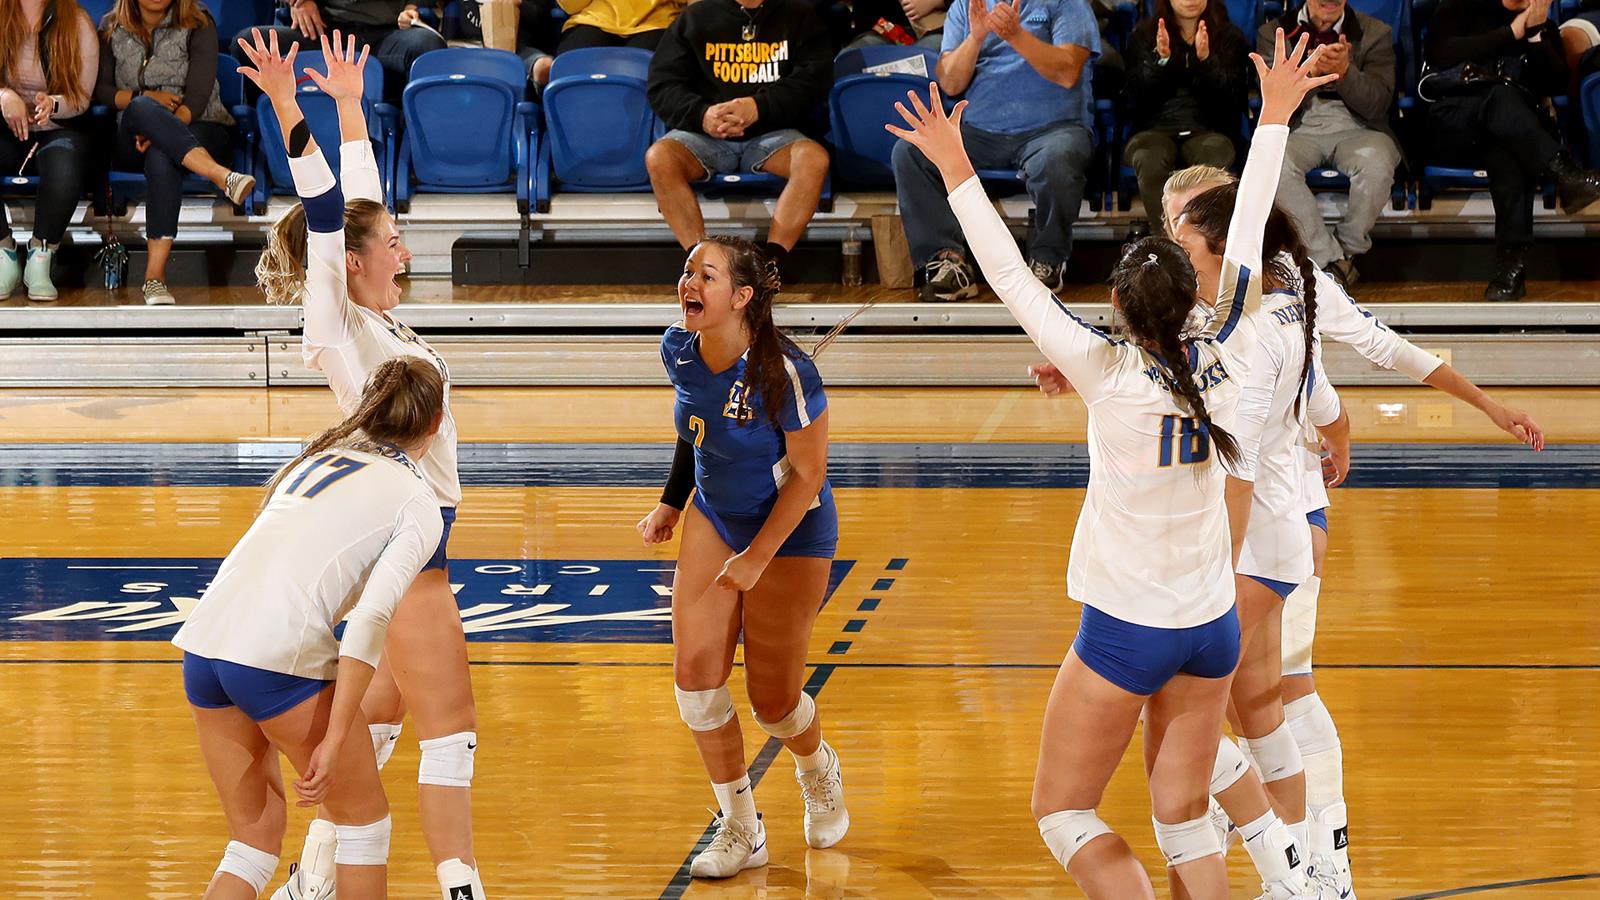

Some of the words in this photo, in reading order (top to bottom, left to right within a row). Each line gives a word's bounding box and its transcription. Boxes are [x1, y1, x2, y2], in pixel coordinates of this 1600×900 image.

[705, 40, 789, 63] PITTSBURGH
[713, 62, 781, 83] FOOTBALL
[285, 454, 370, 498] 17
